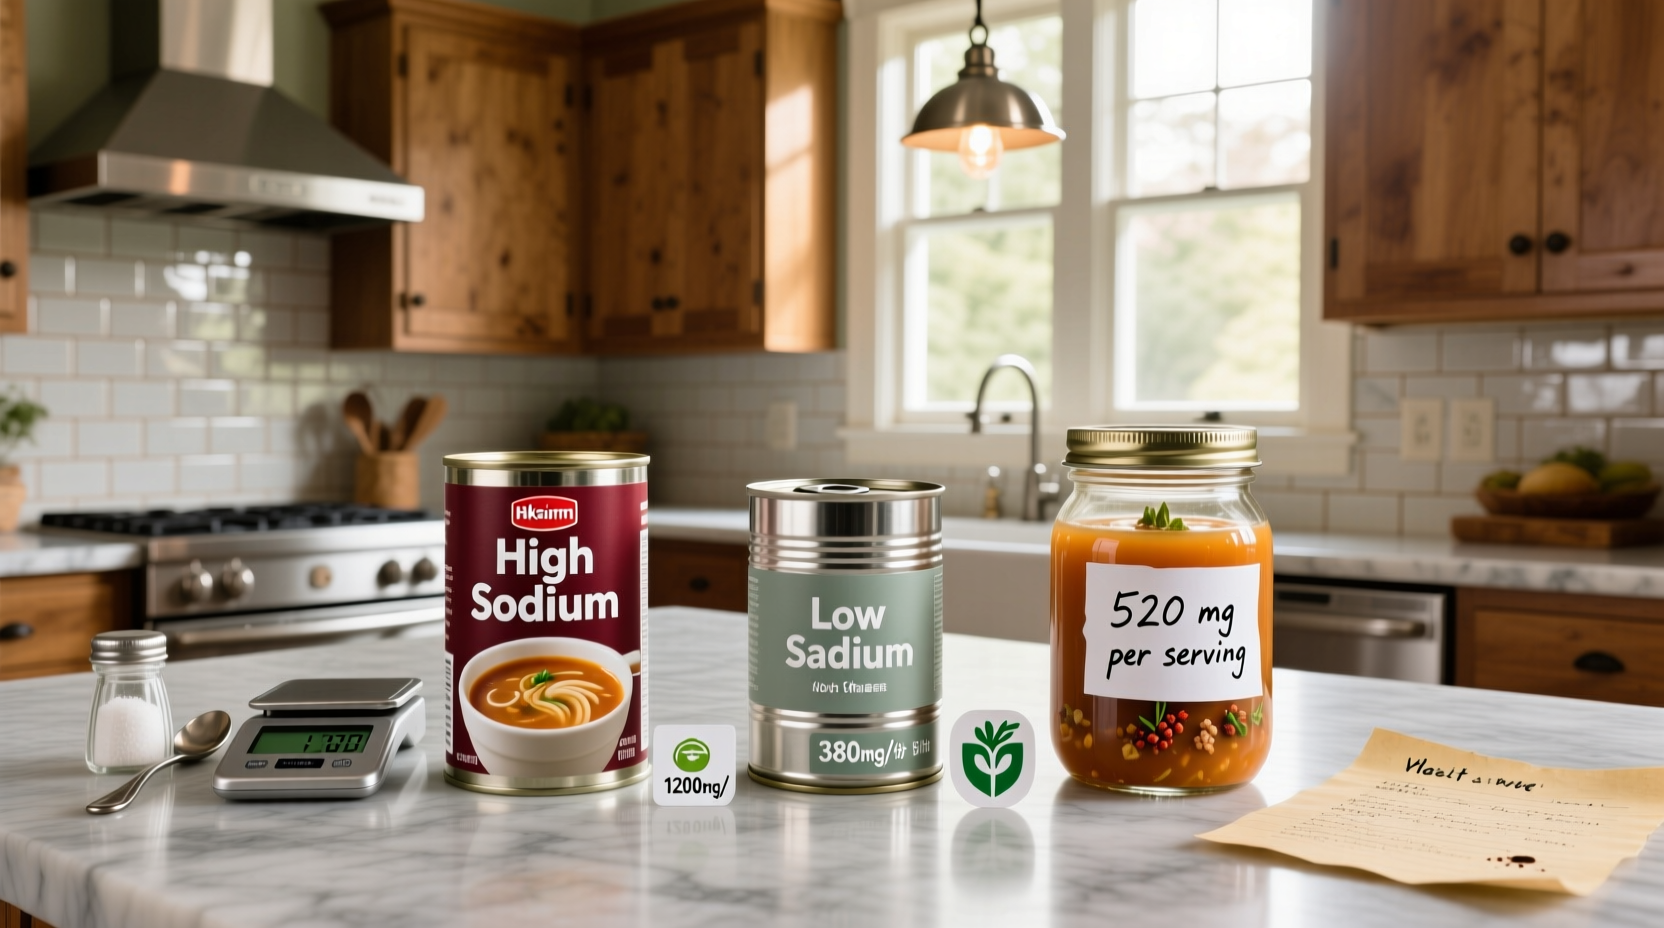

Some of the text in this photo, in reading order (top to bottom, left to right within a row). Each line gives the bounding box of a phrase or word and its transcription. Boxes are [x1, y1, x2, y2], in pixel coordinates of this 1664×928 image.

[496, 536, 594, 584] High
[471, 582, 619, 622] Sodium
[811, 597, 886, 630] Low
[1110, 591, 1235, 638] 520 mg
[785, 636, 914, 669] Sadium
[1106, 640, 1246, 680] per serving
